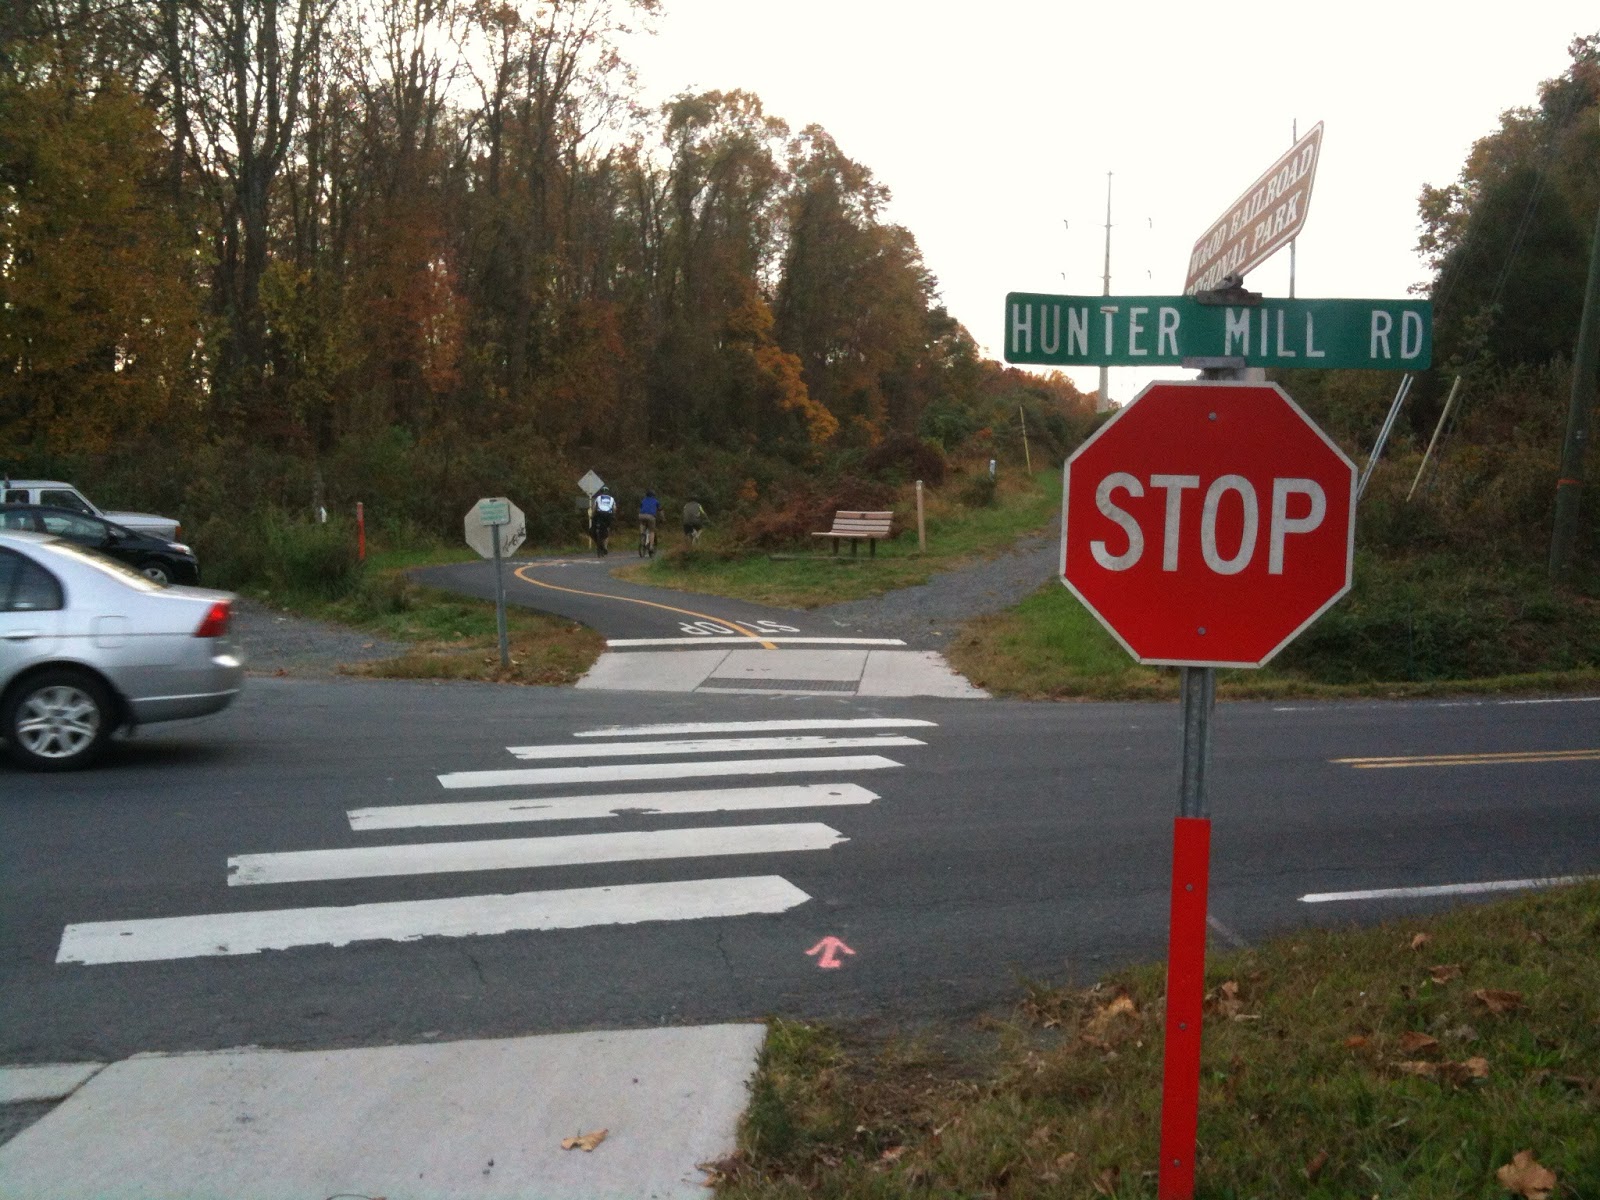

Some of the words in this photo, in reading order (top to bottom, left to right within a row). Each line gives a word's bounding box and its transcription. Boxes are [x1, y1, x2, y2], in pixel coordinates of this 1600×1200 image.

[1228, 143, 1314, 241] RAILROAD
[1250, 189, 1302, 256] PARK
[1011, 303, 1182, 356] HUNTER
[1224, 306, 1325, 358] MILL
[1370, 309, 1424, 360] RD
[1090, 471, 1327, 576] STOP
[678, 620, 800, 635] STOP
